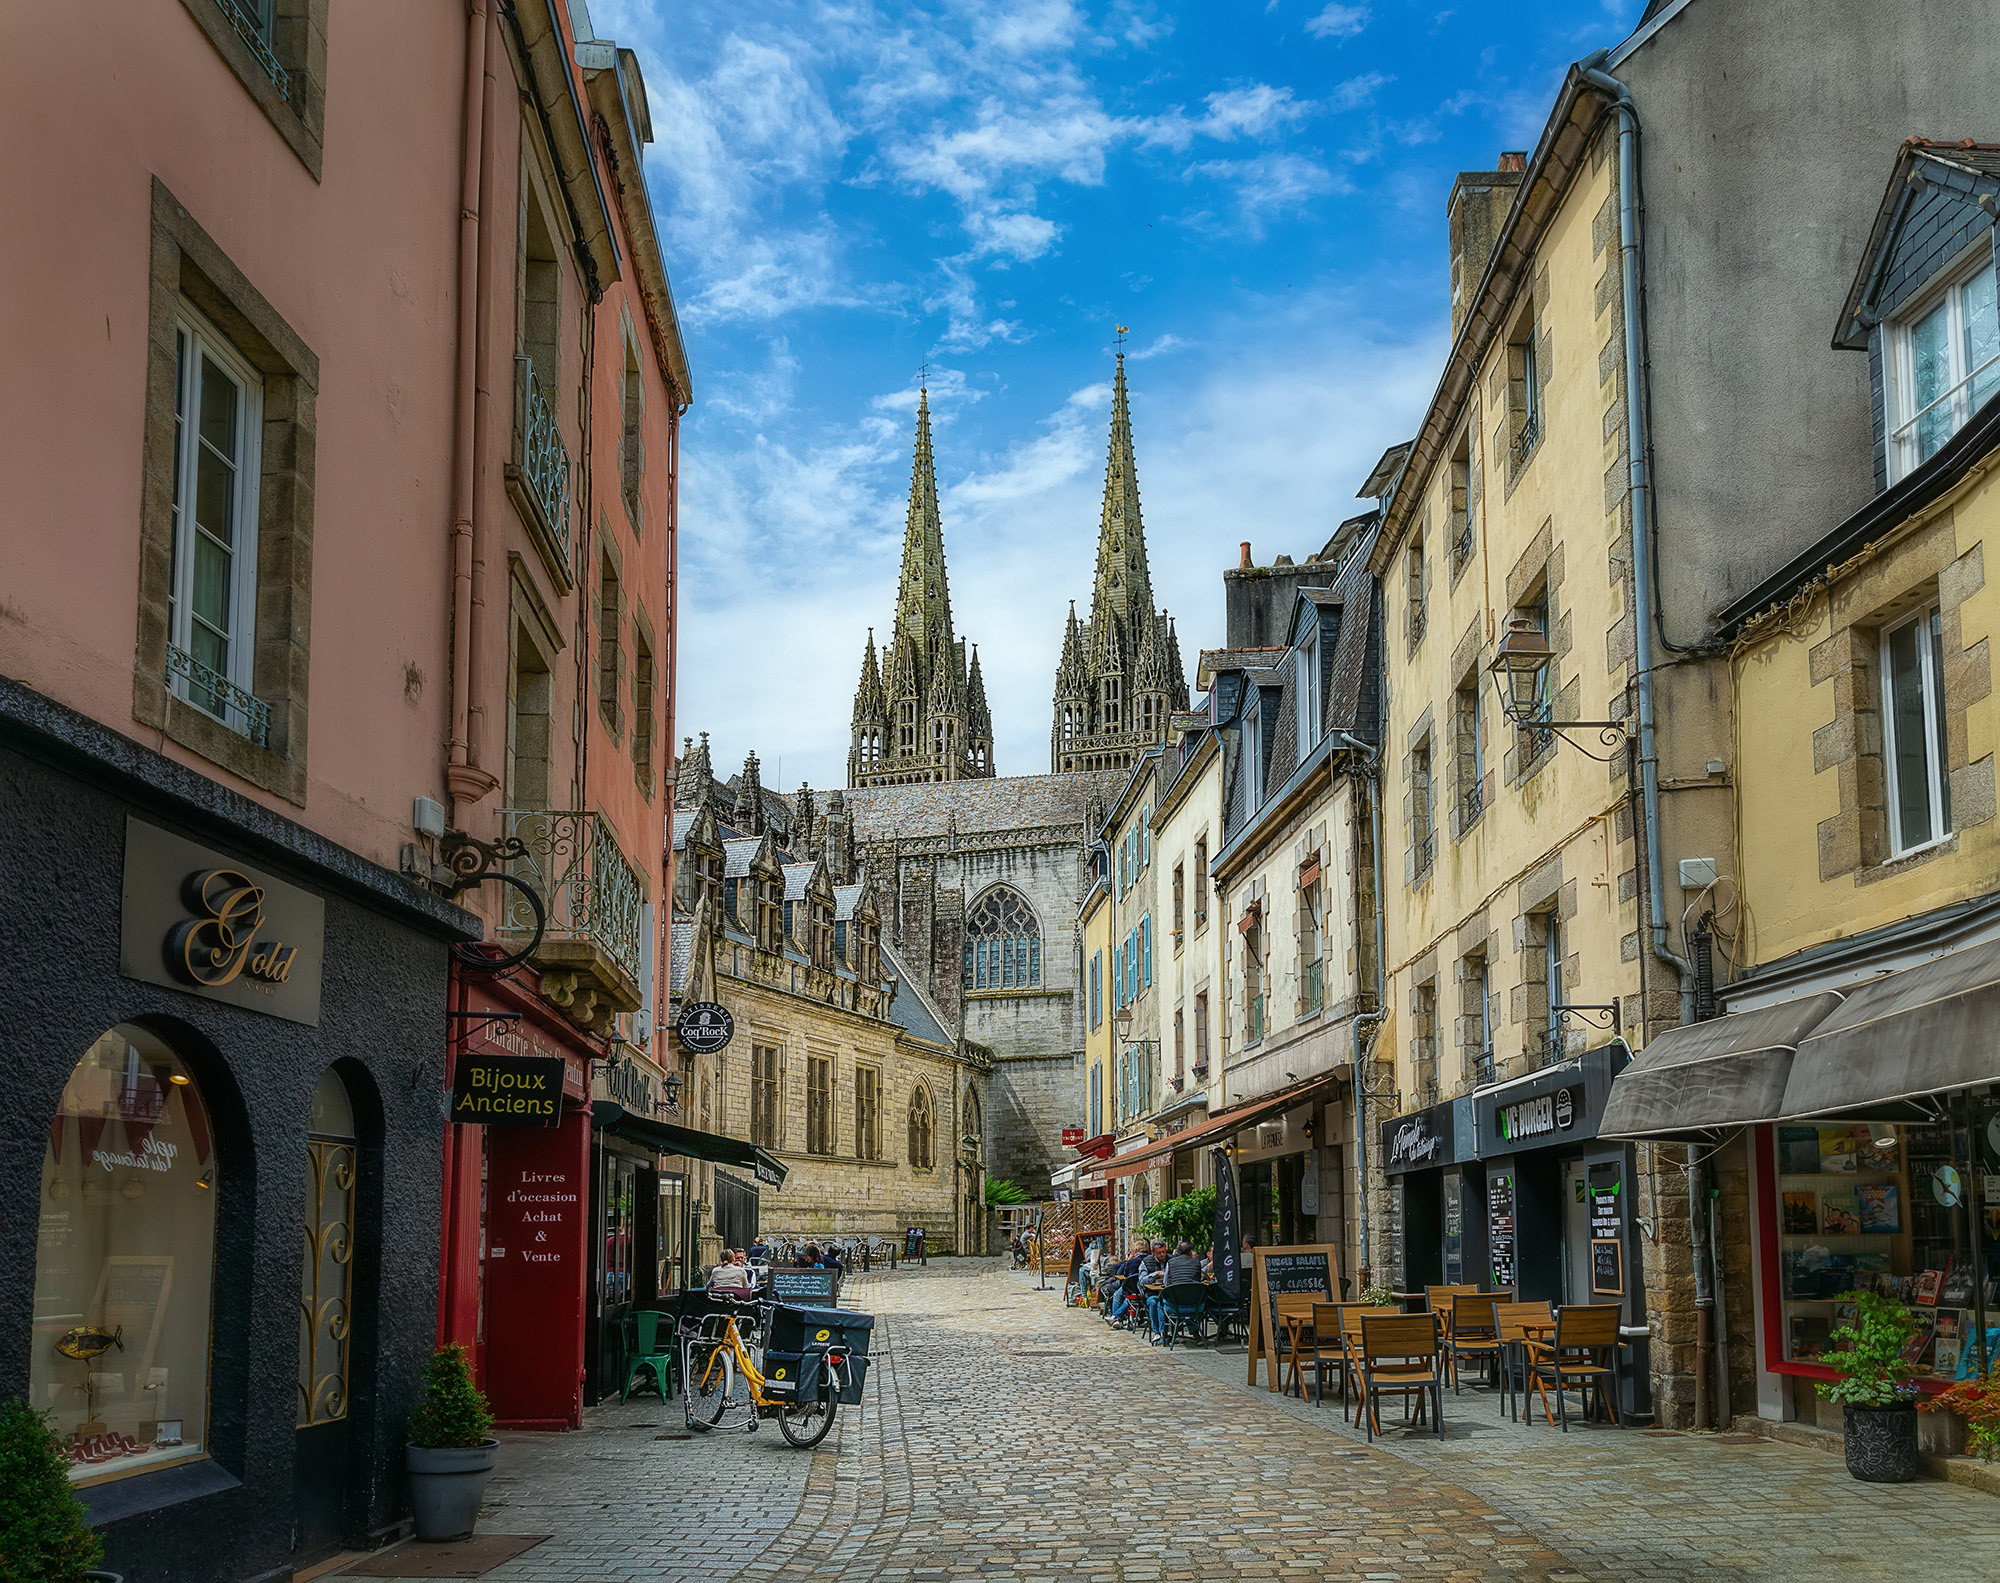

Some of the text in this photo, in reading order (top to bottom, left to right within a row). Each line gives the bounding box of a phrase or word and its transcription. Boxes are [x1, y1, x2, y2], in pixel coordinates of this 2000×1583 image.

[185, 869, 297, 986] Gold
[470, 1067, 546, 1094] Bijoux
[456, 1093, 554, 1115] Anciens
[1505, 1096, 1554, 1139] VG BURGER
[521, 1170, 565, 1183] Livres
[507, 1189, 577, 1203] d'occasion
[521, 1211, 562, 1222] Achat
[535, 1230, 548, 1242] &
[521, 1250, 561, 1262] Vente
[1266, 1256, 1293, 1267] BURGER
[1268, 1277, 1325, 1290] VG CLASSIC
